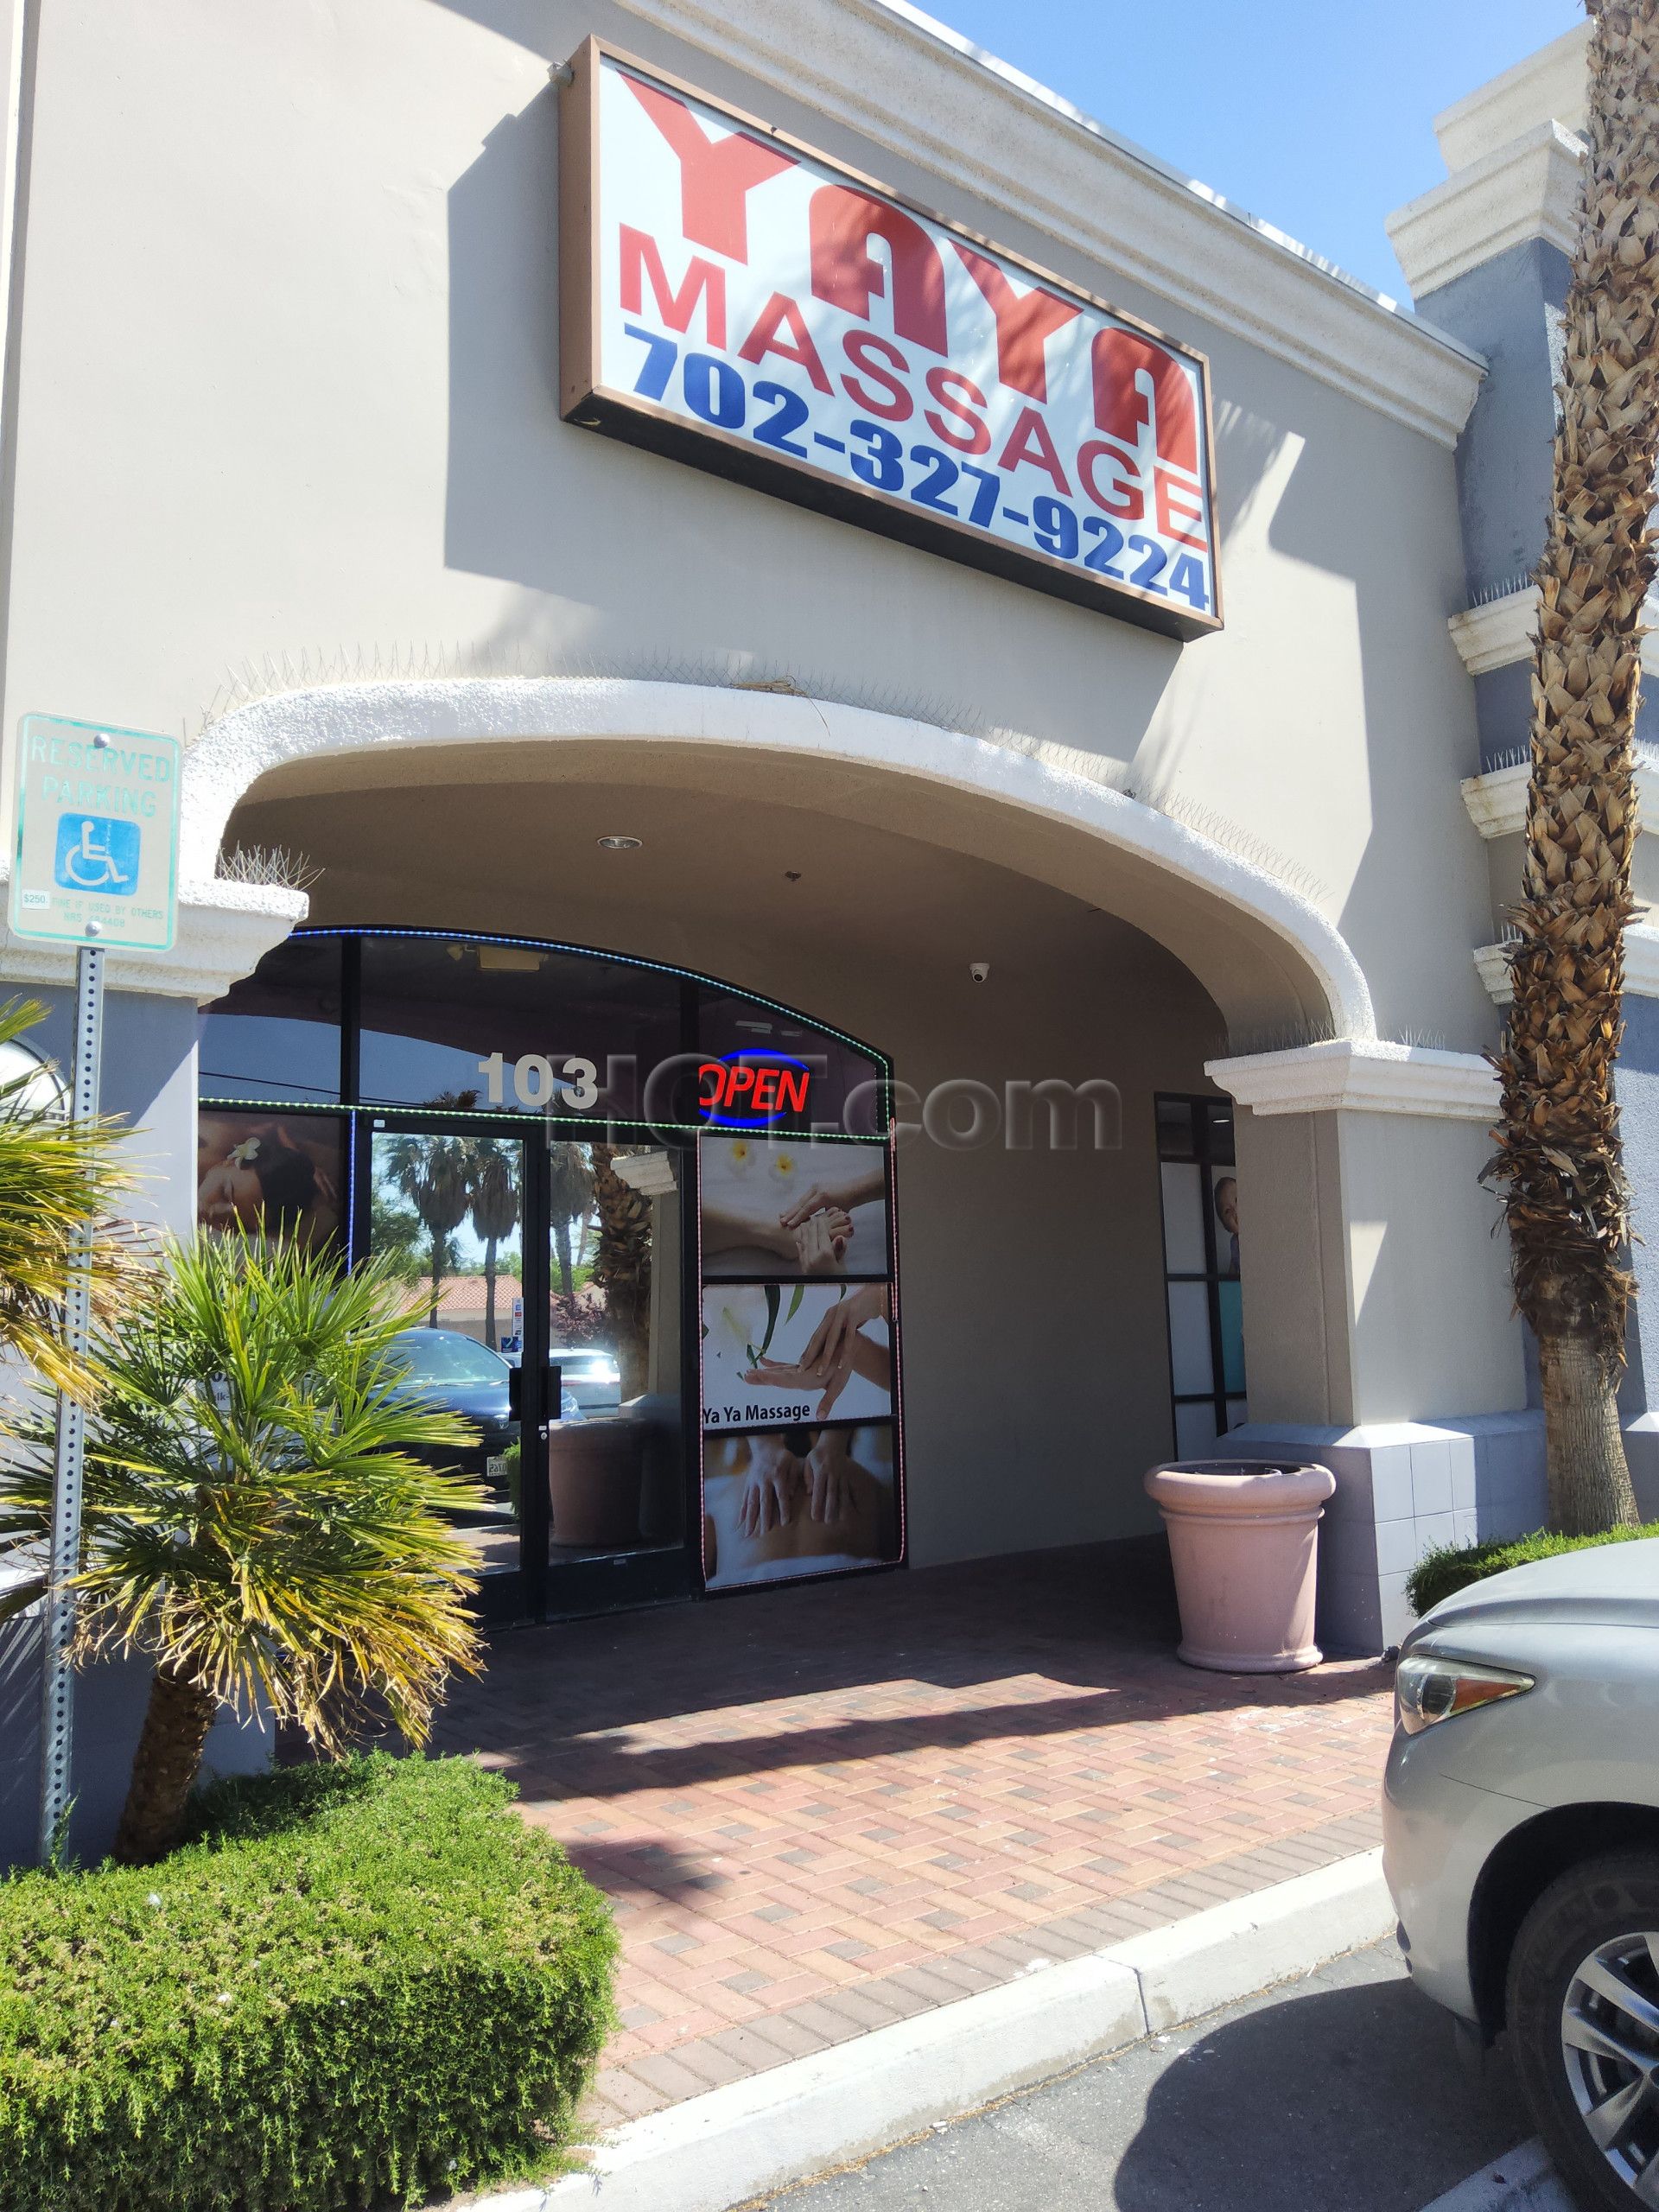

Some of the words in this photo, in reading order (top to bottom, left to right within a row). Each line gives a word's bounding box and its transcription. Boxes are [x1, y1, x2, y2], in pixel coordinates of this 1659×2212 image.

[616, 69, 1198, 476] YAYA
[619, 222, 1209, 553] MASSAGE
[624, 322, 1210, 612] 702-327-9224
[31, 735, 170, 783] RESERVED
[42, 776, 157, 818] PARKING
[52, 897, 71, 909] FINE
[88, 902, 111, 913] USED
[115, 905, 125, 915] BY
[130, 906, 164, 920] OTHERS
[478, 1052, 599, 1109] 103
[698, 1064, 810, 1113] OPEN
[702, 1408, 720, 1424] Ya
[723, 1406, 741, 1422] Ya
[745, 1404, 810, 1421] Massage
